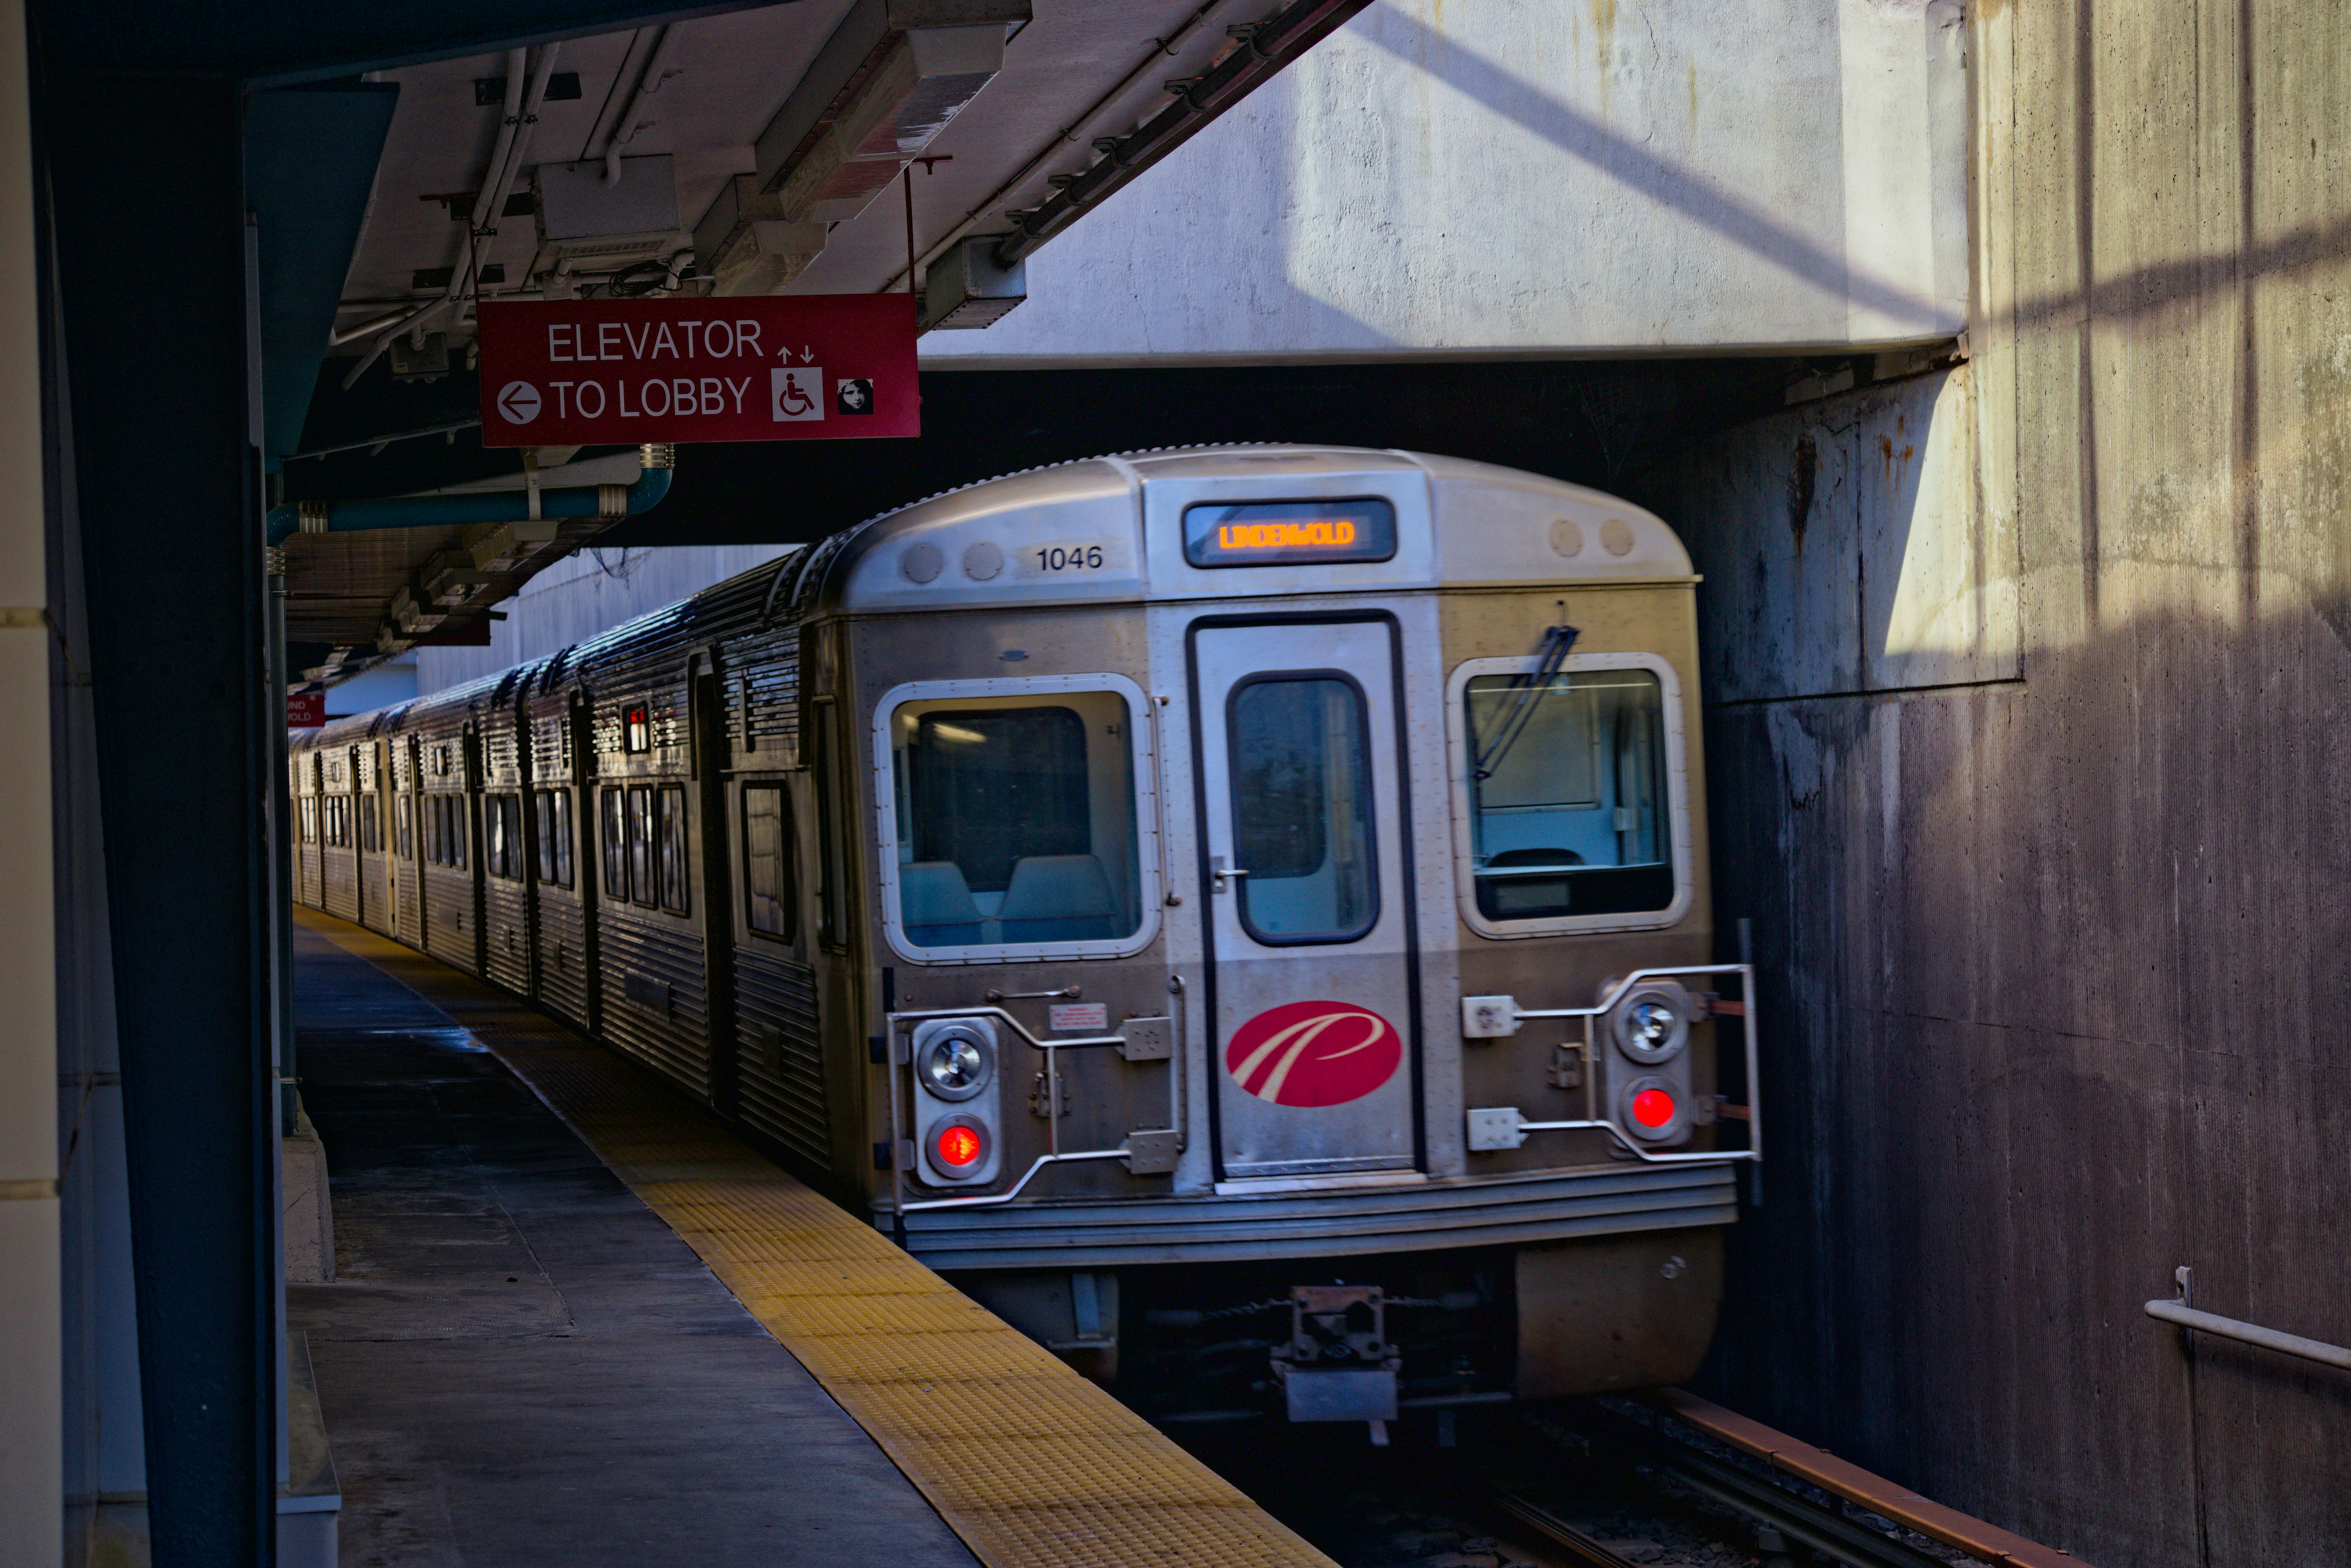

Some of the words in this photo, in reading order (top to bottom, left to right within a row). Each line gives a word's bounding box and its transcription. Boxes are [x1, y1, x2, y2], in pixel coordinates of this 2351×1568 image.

[549, 320, 764, 362] ELEVATOR
[549, 380, 605, 419] TO
[619, 376, 752, 417] LOBBY
[1037, 546, 1102, 571] 1046
